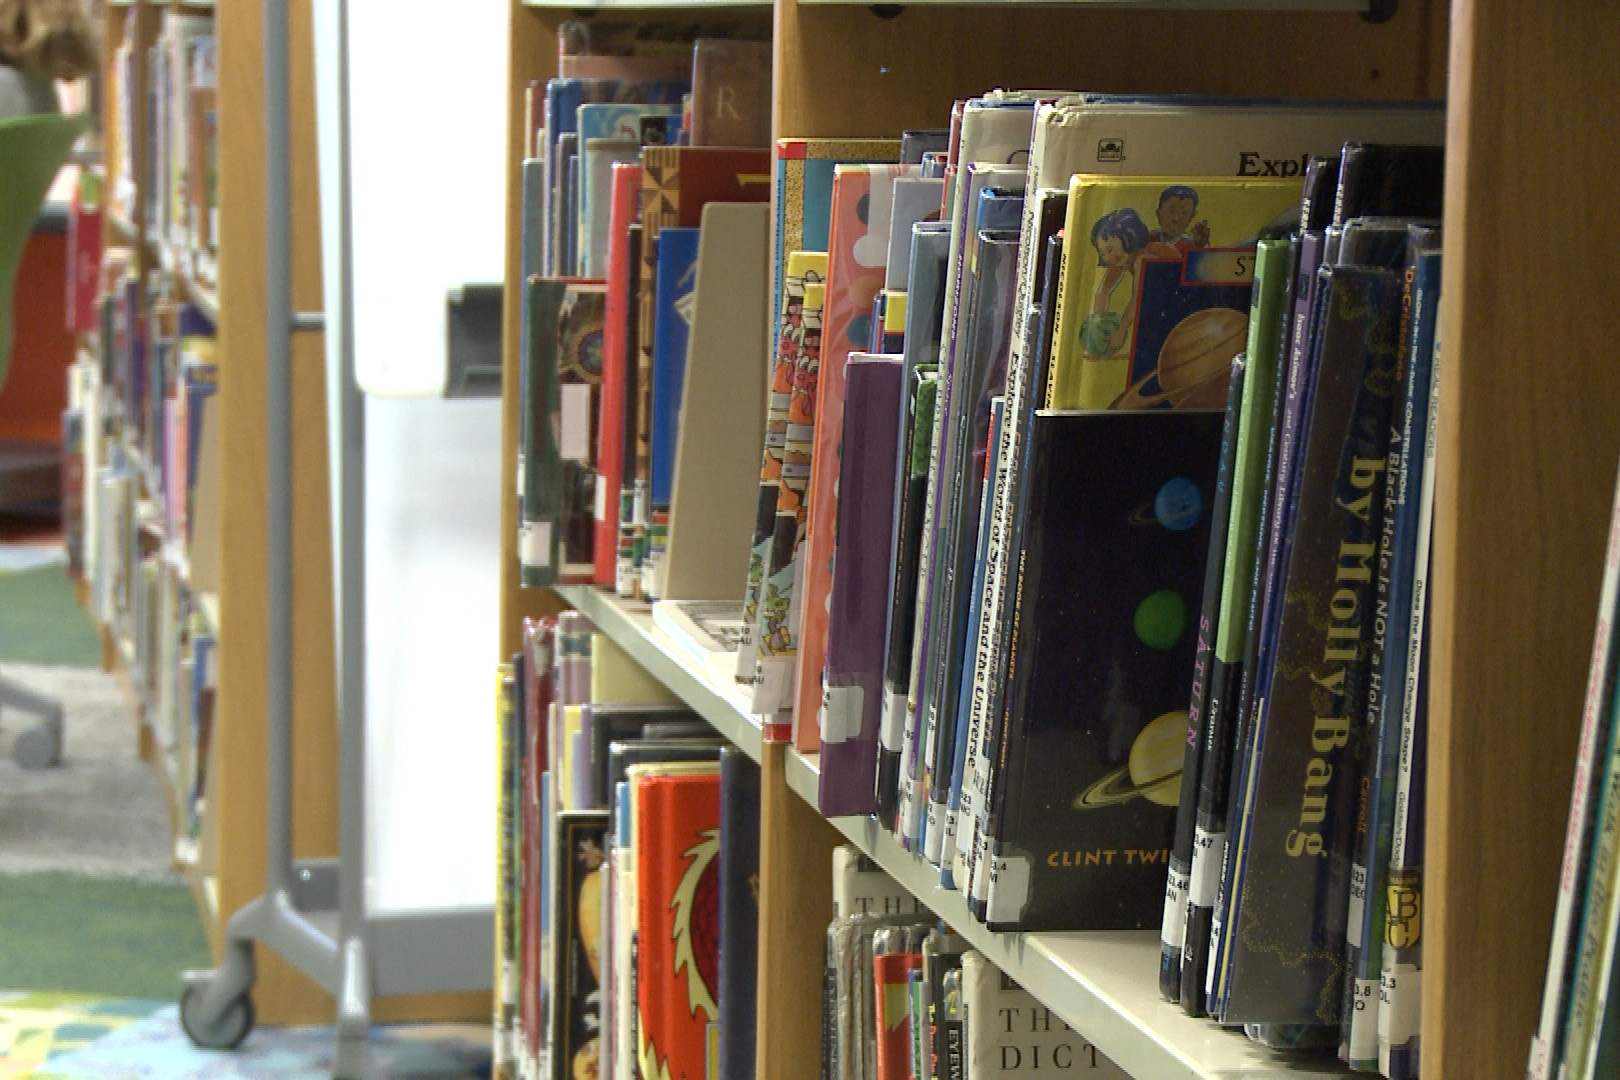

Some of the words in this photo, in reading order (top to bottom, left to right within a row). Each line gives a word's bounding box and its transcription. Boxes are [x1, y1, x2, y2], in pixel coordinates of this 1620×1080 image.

[1003, 351, 1019, 428] Explore
[1000, 431, 1013, 462] the
[1389, 426, 1401, 444] A
[994, 468, 1008, 521] World
[1336, 455, 1386, 521] by
[1385, 452, 1401, 512] Black
[991, 526, 1004, 545] of
[1379, 517, 1394, 569] Hole
[983, 548, 999, 608] Space
[980, 612, 993, 649] and
[1310, 538, 1376, 698] Molly
[1373, 599, 1387, 650] NOT
[976, 652, 989, 681] the
[1186, 614, 1211, 749] SATURN
[1371, 653, 1381, 666] a
[1367, 673, 1382, 725] Hole
[1403, 677, 1416, 723] Change
[969, 686, 986, 768] Universe
[1286, 715, 1350, 859] Bang
[1046, 848, 1117, 868] CLINT
[1125, 848, 1173, 868] TWI
[1000, 1043, 1101, 1071] DICT
